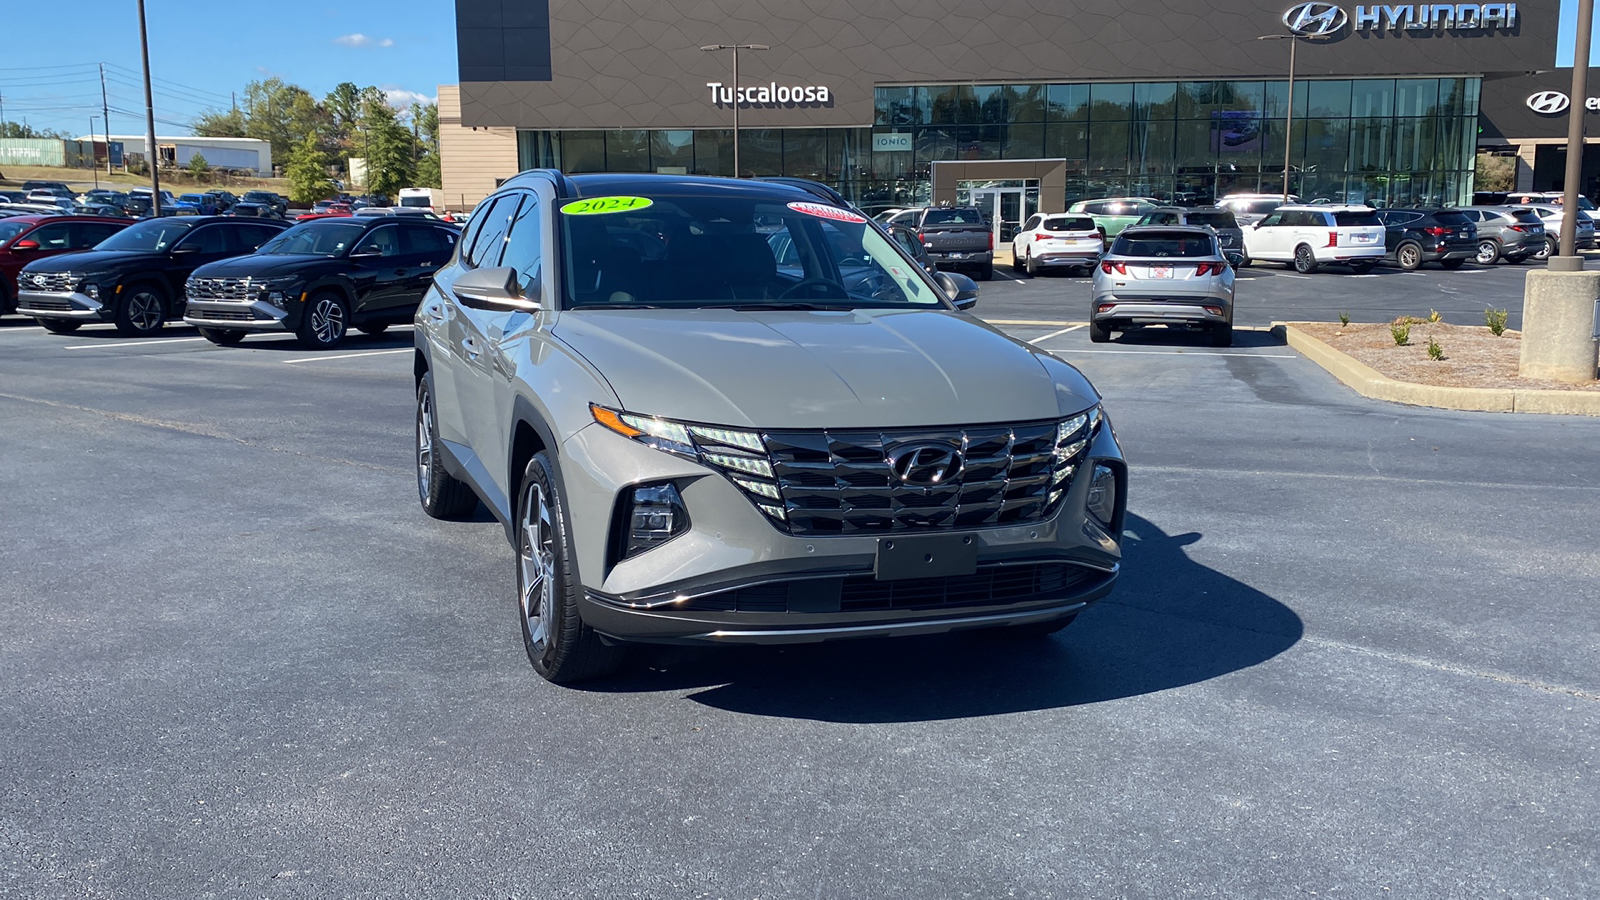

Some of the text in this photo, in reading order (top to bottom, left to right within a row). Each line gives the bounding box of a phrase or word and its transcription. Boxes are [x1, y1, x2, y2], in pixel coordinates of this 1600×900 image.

[1355, 3, 1517, 31] HYUNDAI
[706, 82, 829, 103] Tuscaloosa
[577, 198, 637, 213] 2024
